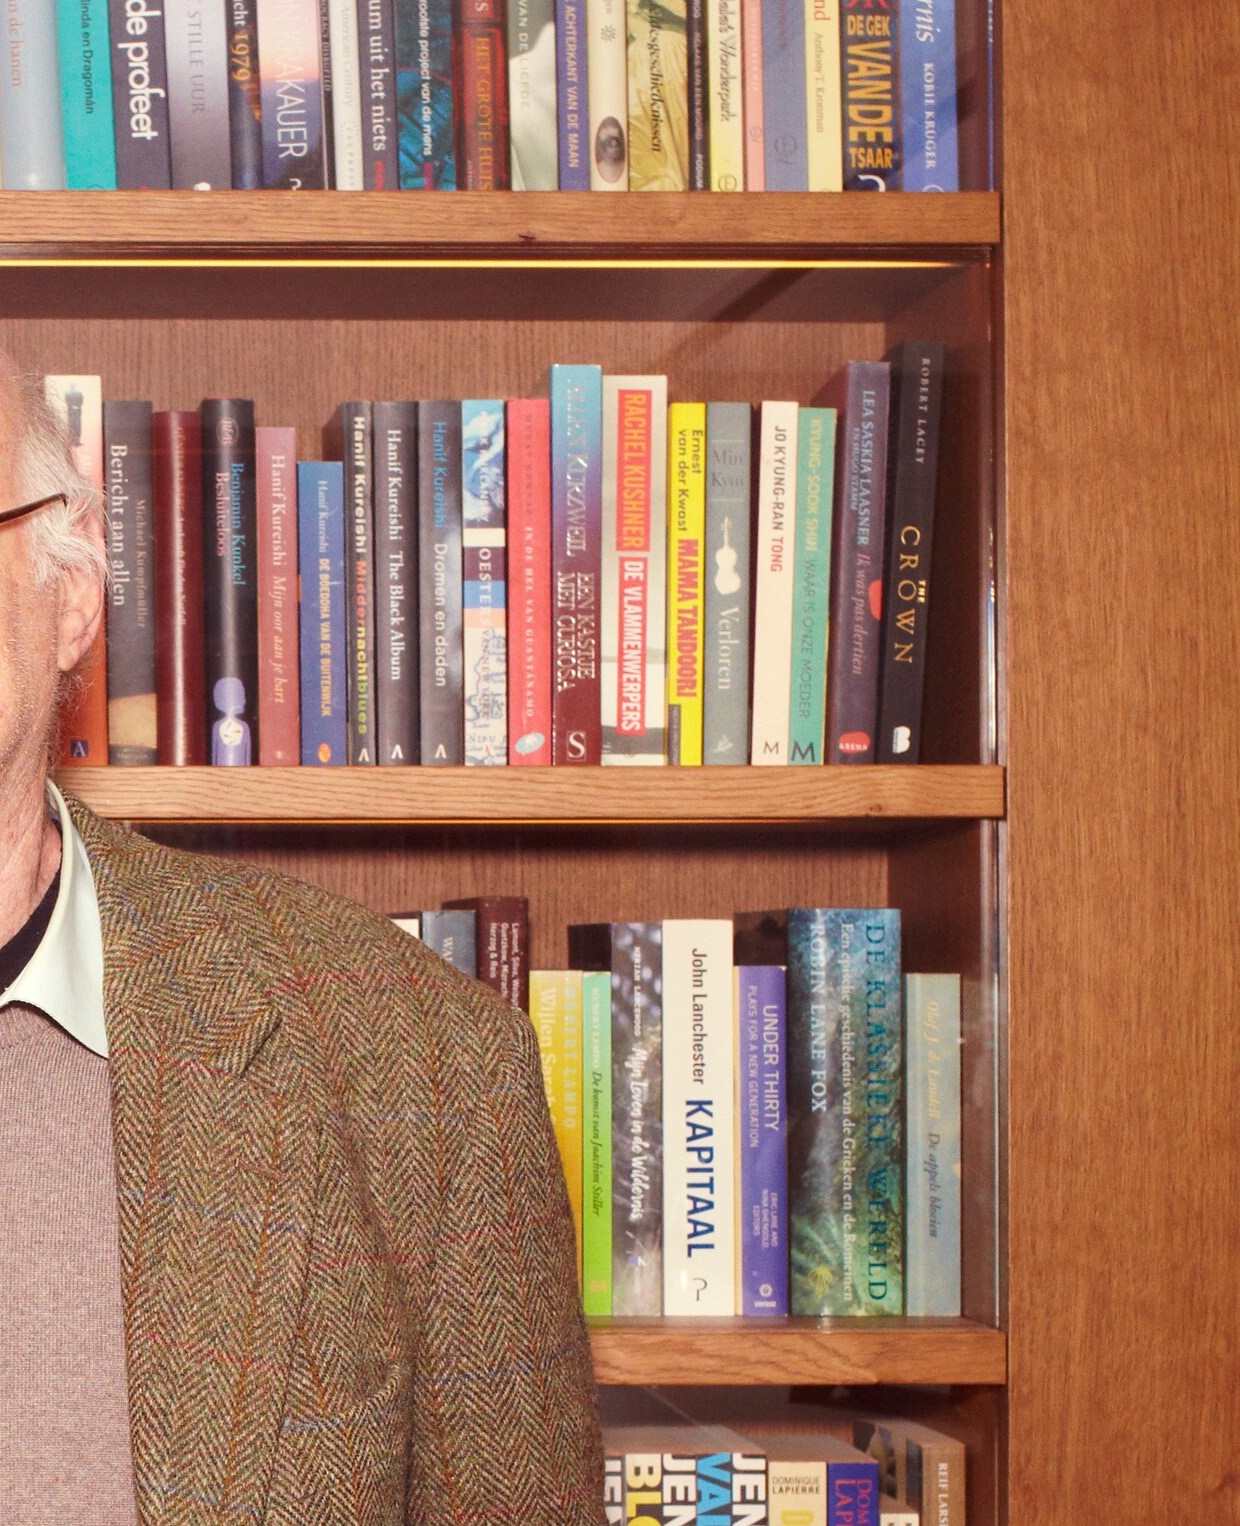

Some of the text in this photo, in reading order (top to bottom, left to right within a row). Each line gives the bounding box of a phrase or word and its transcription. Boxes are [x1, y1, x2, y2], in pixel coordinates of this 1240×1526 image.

[118, 0, 166, 140] de profeet
[232, 33, 251, 81] 1979
[369, 36, 389, 151] uit het niets
[109, 445, 131, 606] Bericht aan allen
[214, 472, 230, 557] Besluiteloos
[229, 463, 247, 585] Benjamin Kunkel
[623, 394, 647, 547] RACHEL KUSHNER
[770, 425, 788, 572] JO KYUNG-RAN TONG
[386, 429, 405, 681] Hanif Kureishi The Black Album
[677, 539, 699, 603] MAMA
[894, 525, 922, 663] CROWN
[917, 579, 926, 604] THE
[621, 560, 646, 730] DE VLAMMENWERPERS
[676, 606, 699, 698] TANDOORI
[717, 605, 741, 691] Verloren
[763, 1005, 780, 1131] UNDER THIRTY
[809, 923, 828, 1113] ROBIN LANE FOX
[686, 948, 715, 1259] John Lanchester KAPITAAL
[865, 924, 890, 1302] DE KLASSIEKE WERELD
